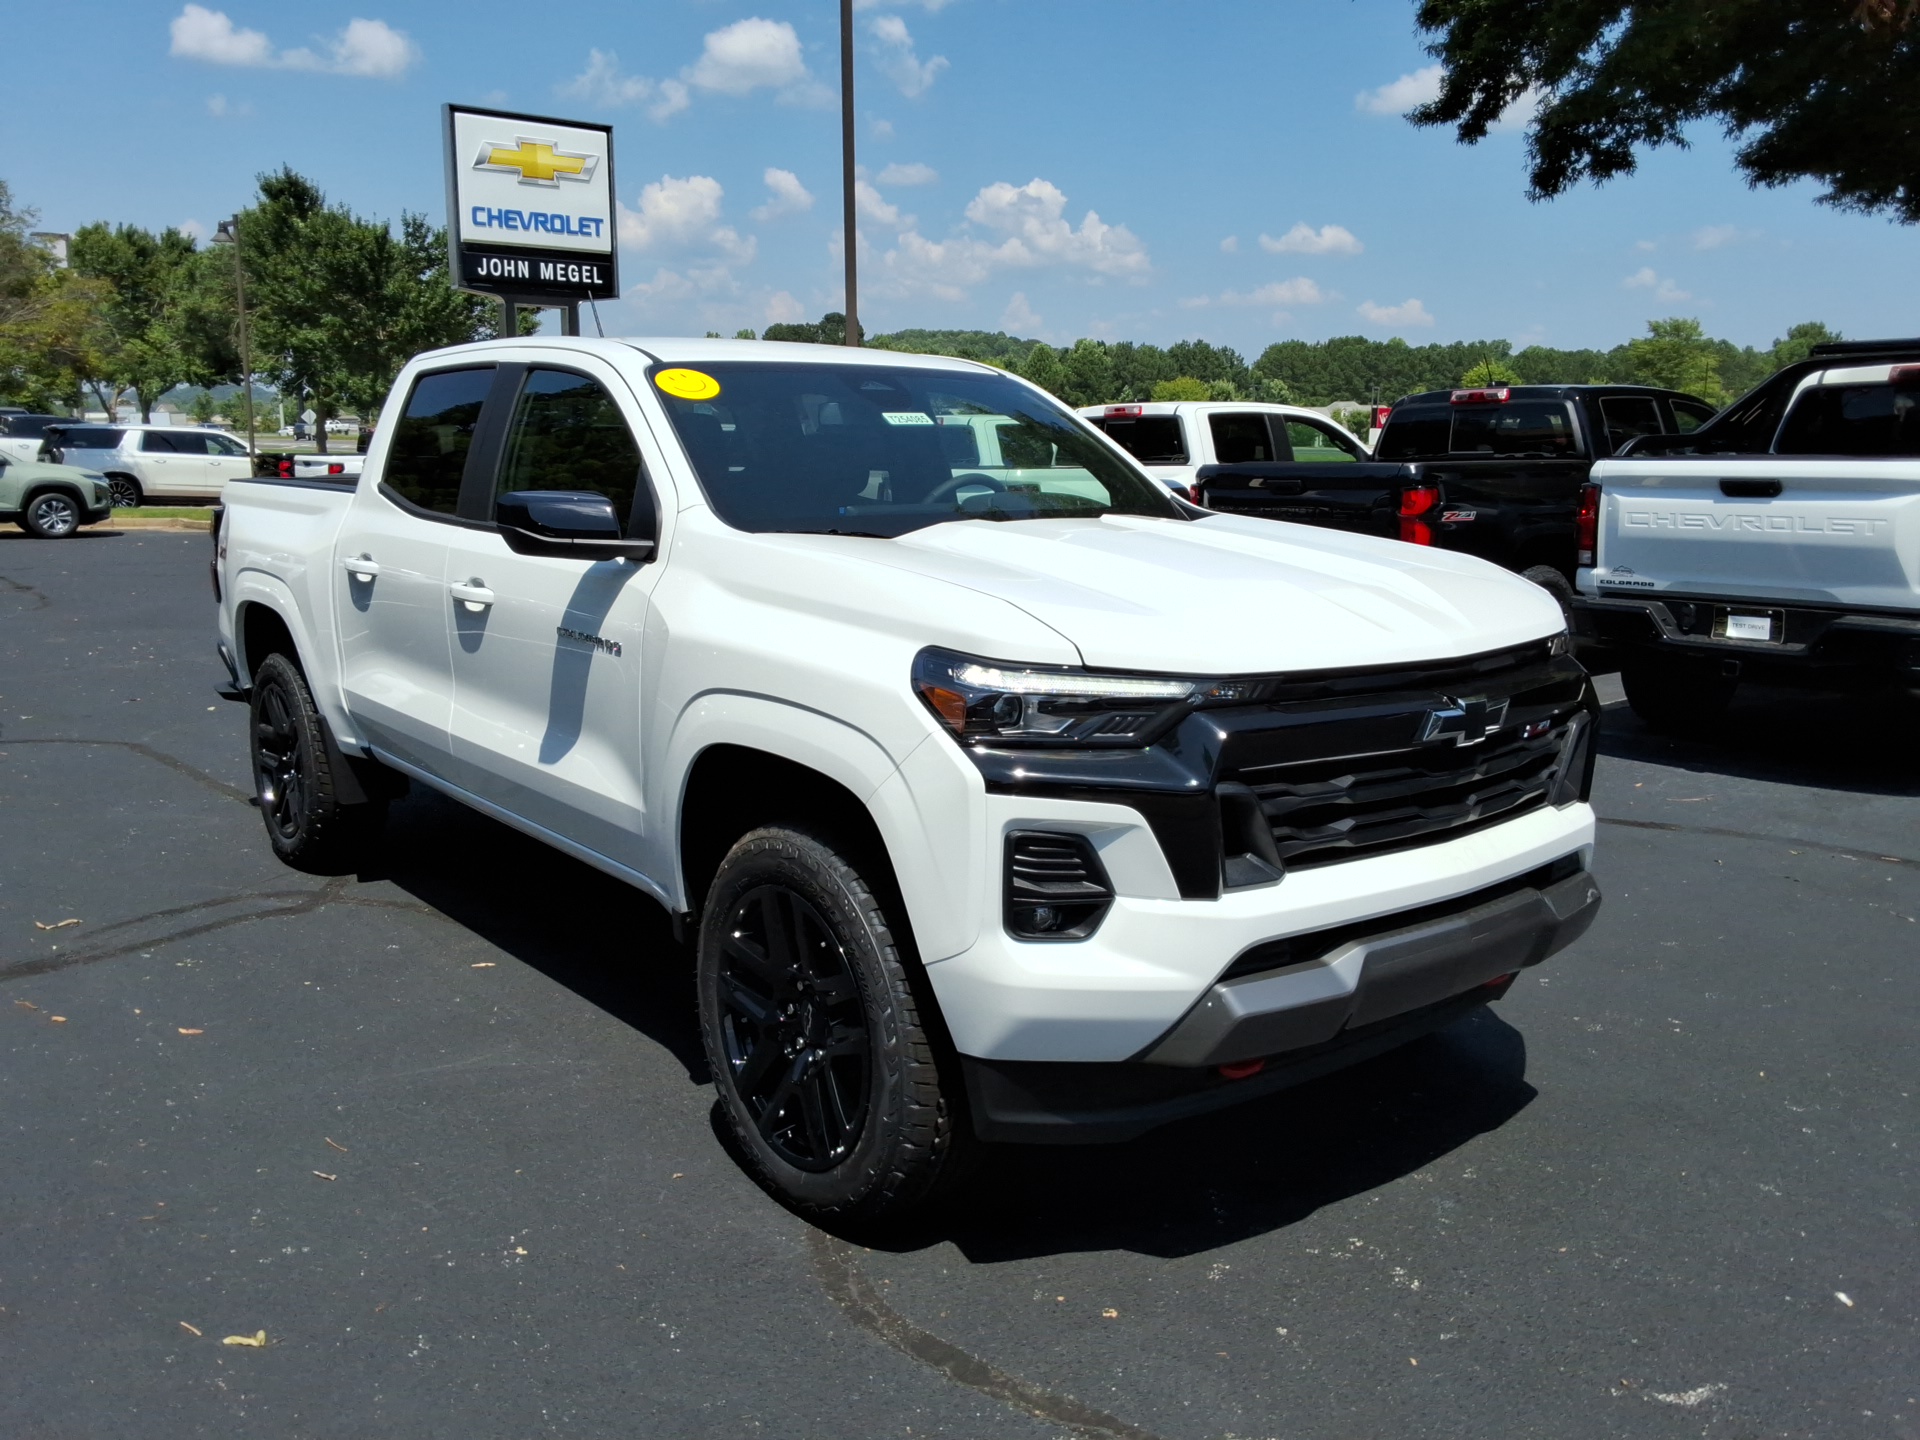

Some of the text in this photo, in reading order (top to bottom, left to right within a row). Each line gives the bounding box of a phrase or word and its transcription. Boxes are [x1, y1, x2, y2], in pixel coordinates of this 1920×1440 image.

[471, 206, 604, 237] CHEVROLET
[477, 257, 603, 284] JOHN MEGEL
[1624, 511, 1888, 536] CHEVROLET
[1600, 579, 1655, 587] COLORADO
